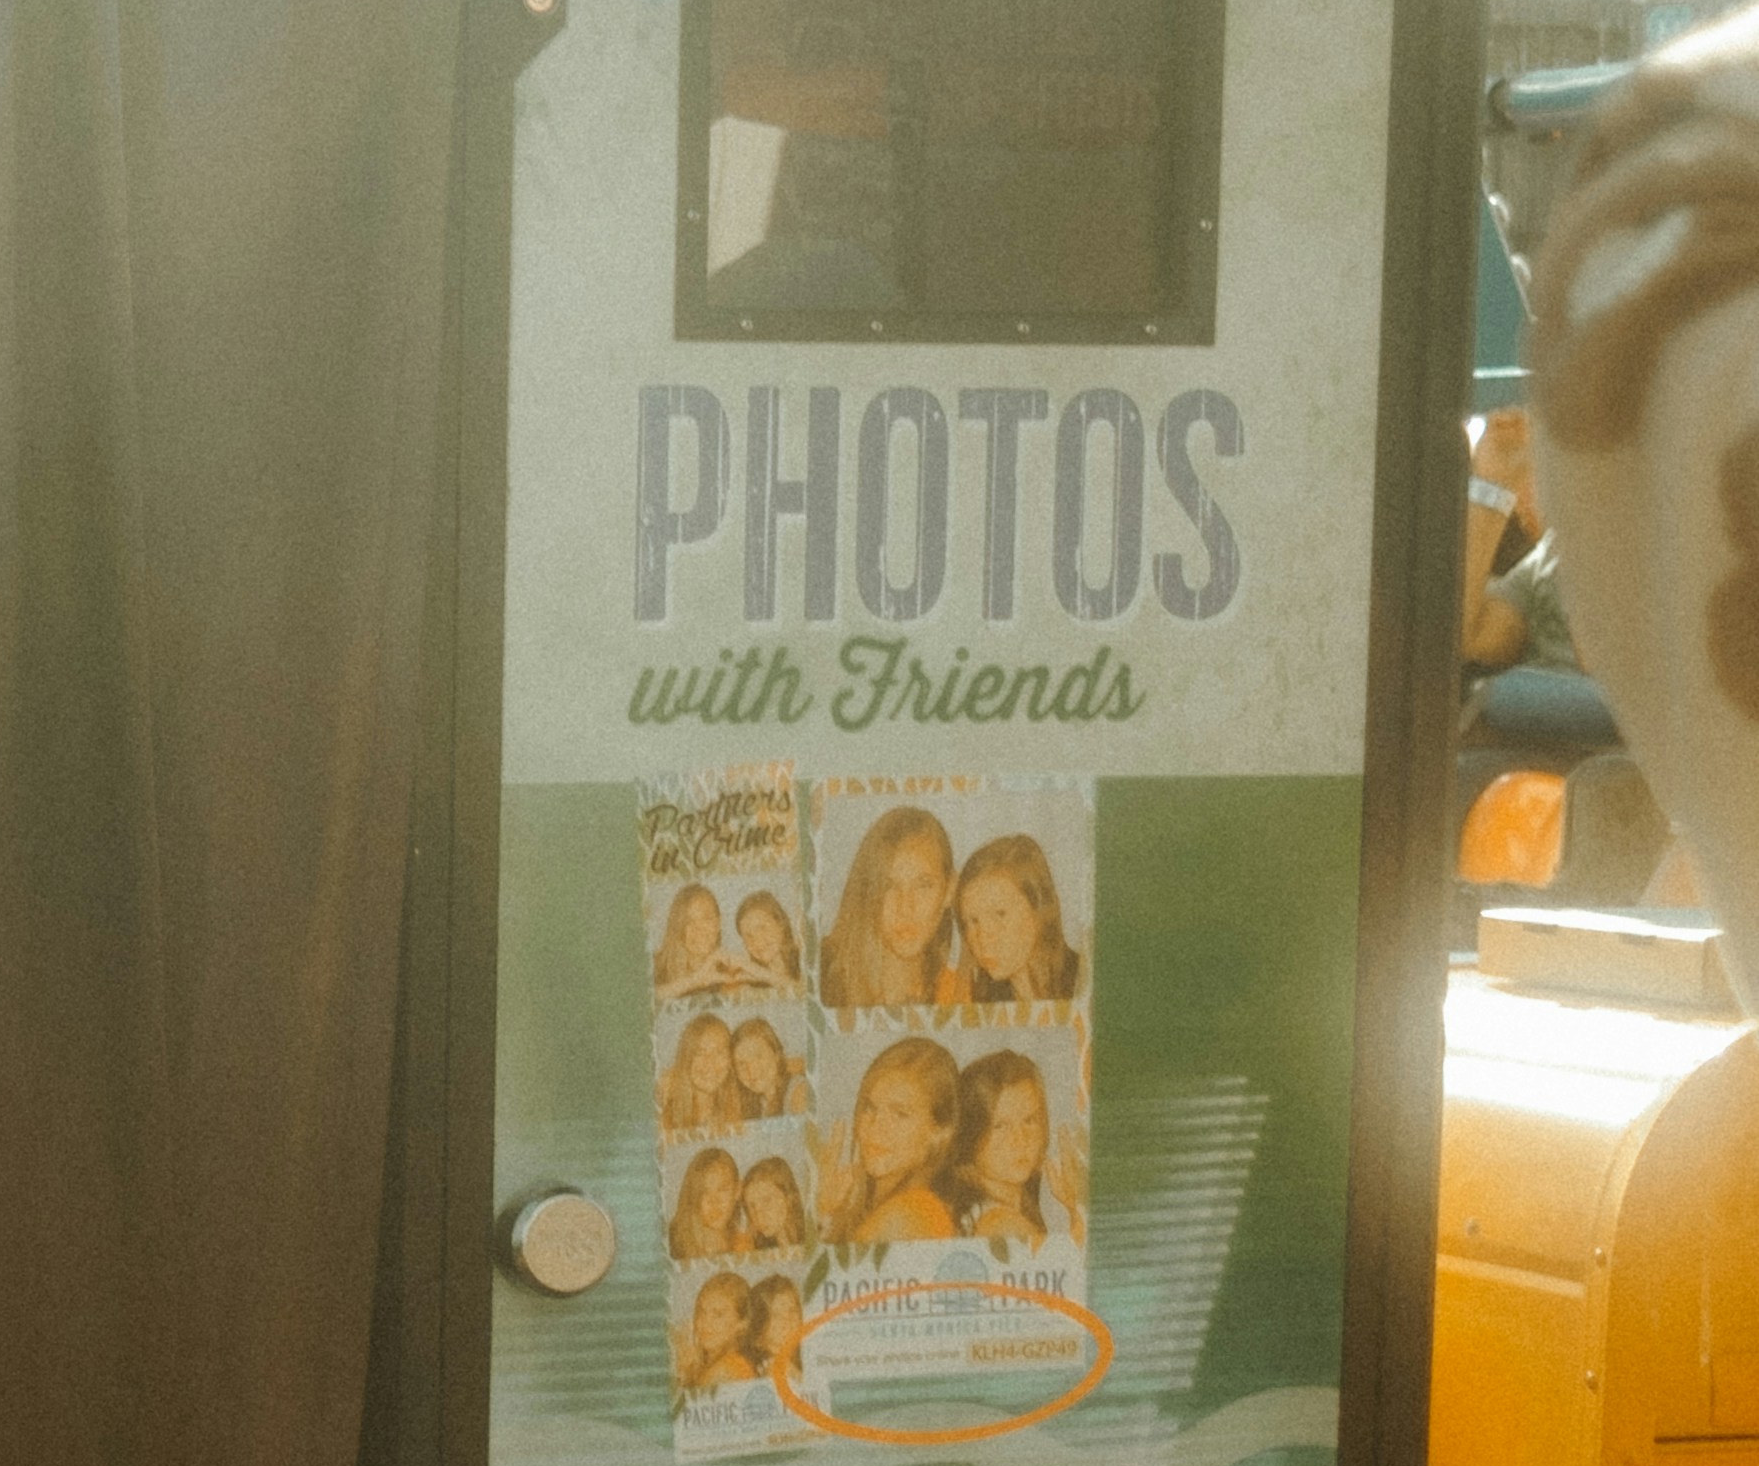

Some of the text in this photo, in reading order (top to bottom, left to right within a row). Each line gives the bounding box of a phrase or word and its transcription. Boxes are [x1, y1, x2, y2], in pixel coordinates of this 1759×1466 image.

[635, 385, 1244, 624] PHOTOS
[628, 635, 1146, 733] with Friends
[644, 787, 792, 843] Partners
[650, 824, 787, 874] in Crime
[824, 1276, 921, 1314] PACIFIC
